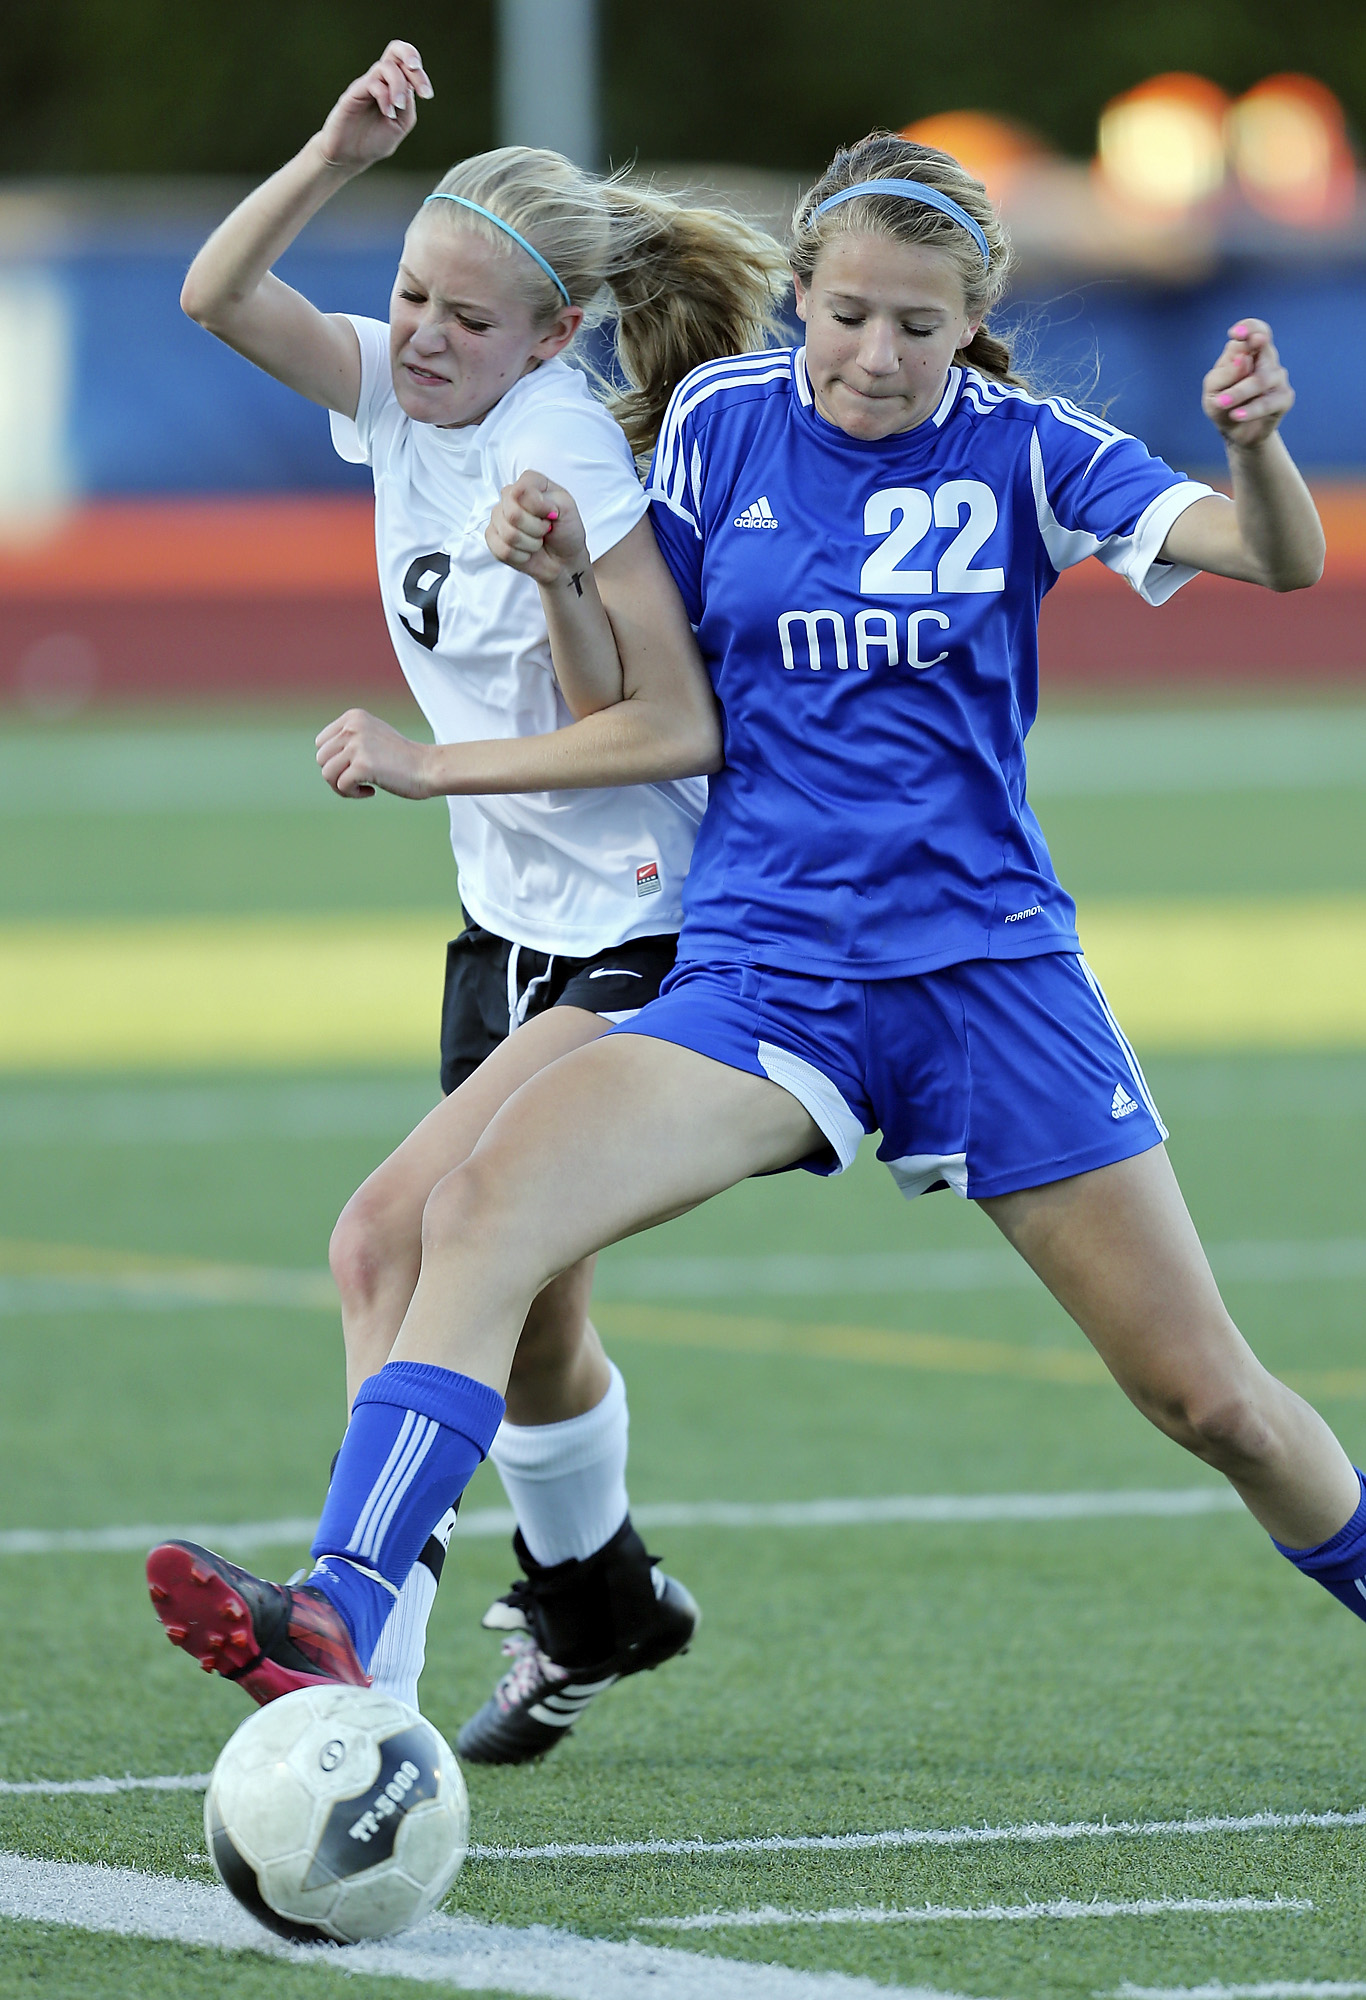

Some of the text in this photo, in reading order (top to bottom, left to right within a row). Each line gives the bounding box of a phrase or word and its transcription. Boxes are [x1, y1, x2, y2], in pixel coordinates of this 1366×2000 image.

[733, 515, 779, 529] adidas
[860, 479, 1005, 594] 22
[398, 551, 451, 652] 9
[777, 608, 950, 671] MAC
[1111, 1100, 1139, 1119] adidas
[348, 1760, 420, 1842] TF-5000
